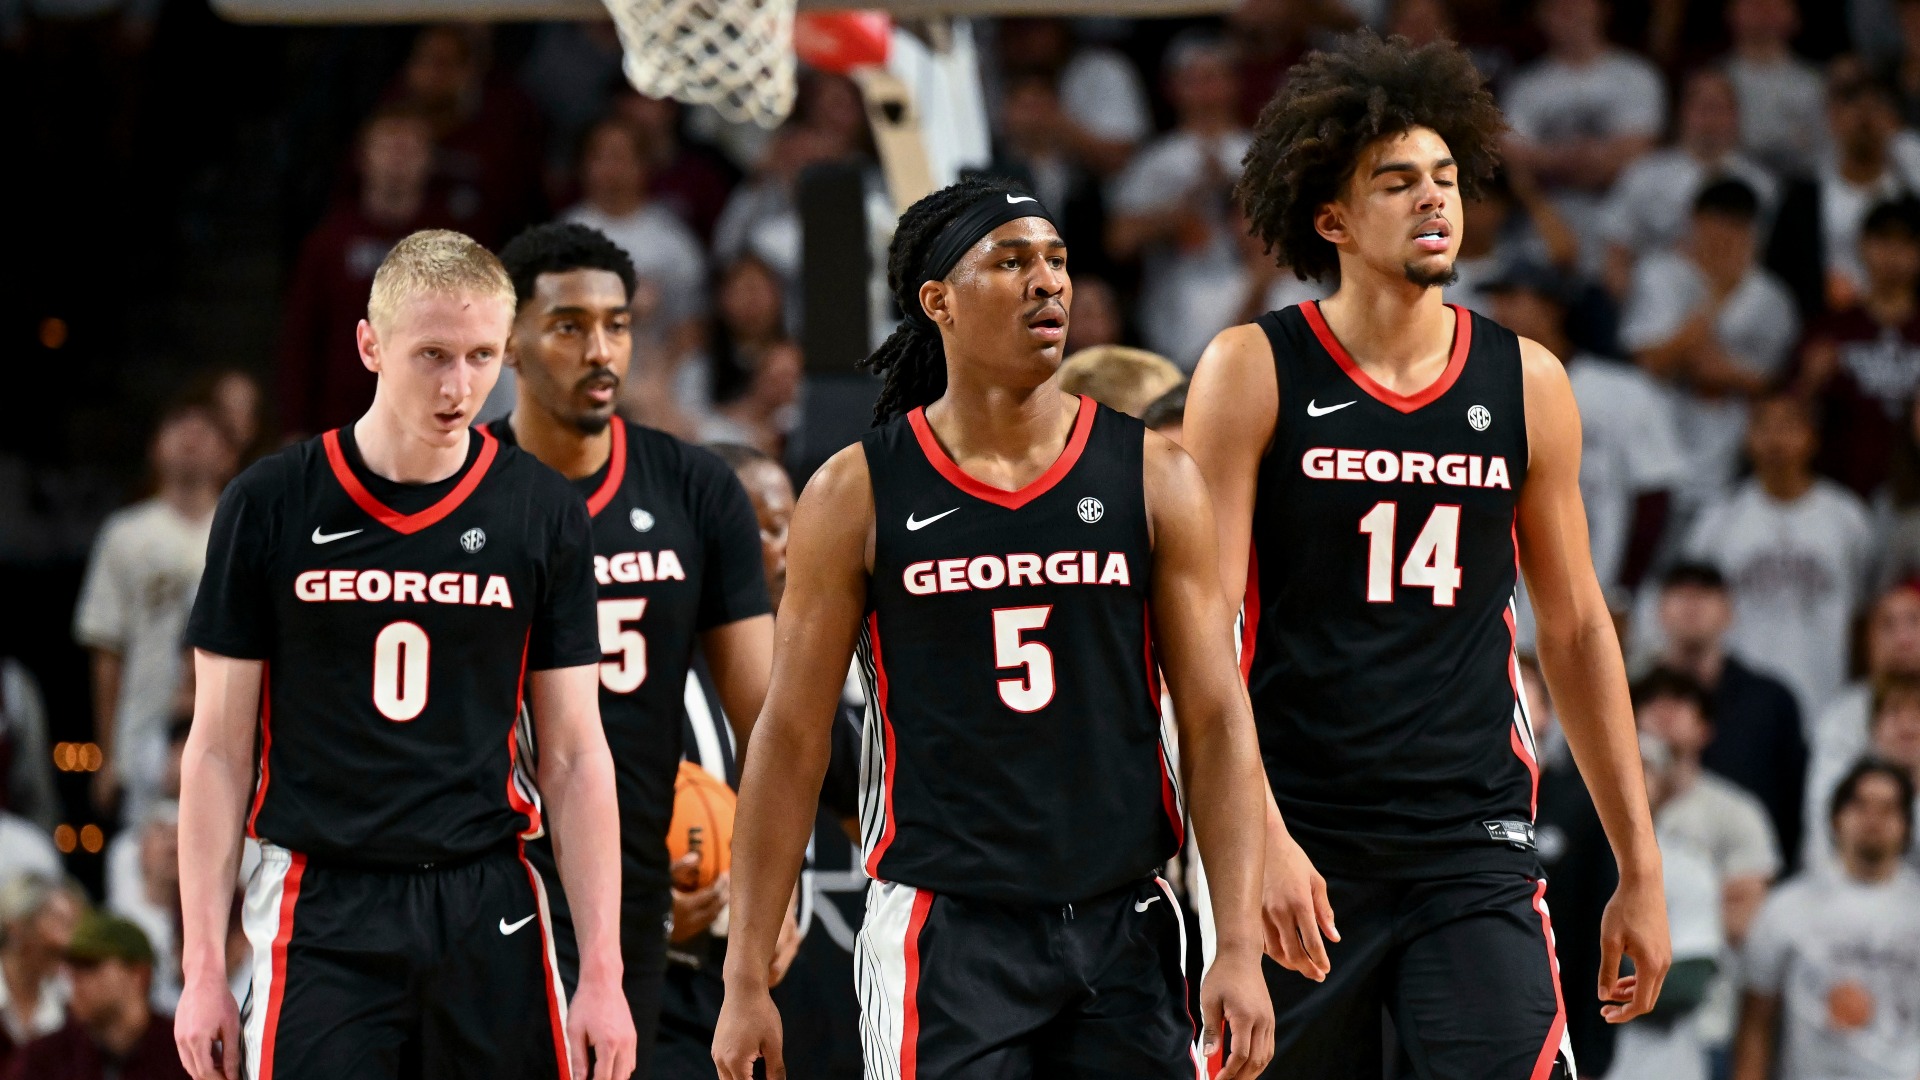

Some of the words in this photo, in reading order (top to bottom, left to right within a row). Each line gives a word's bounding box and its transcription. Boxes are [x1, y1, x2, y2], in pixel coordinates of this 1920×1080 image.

[1468, 406, 1490, 430] SEC
[1302, 447, 1511, 490] GEORGIA
[1079, 498, 1103, 522] SEC
[461, 529, 485, 552] SEC
[1358, 501, 1462, 606] 14
[593, 549, 686, 584] RGIA
[902, 550, 1131, 595] GEORGIA
[294, 569, 514, 608] GEORGIA
[373, 620, 431, 722] 0
[991, 604, 1056, 713] 5
